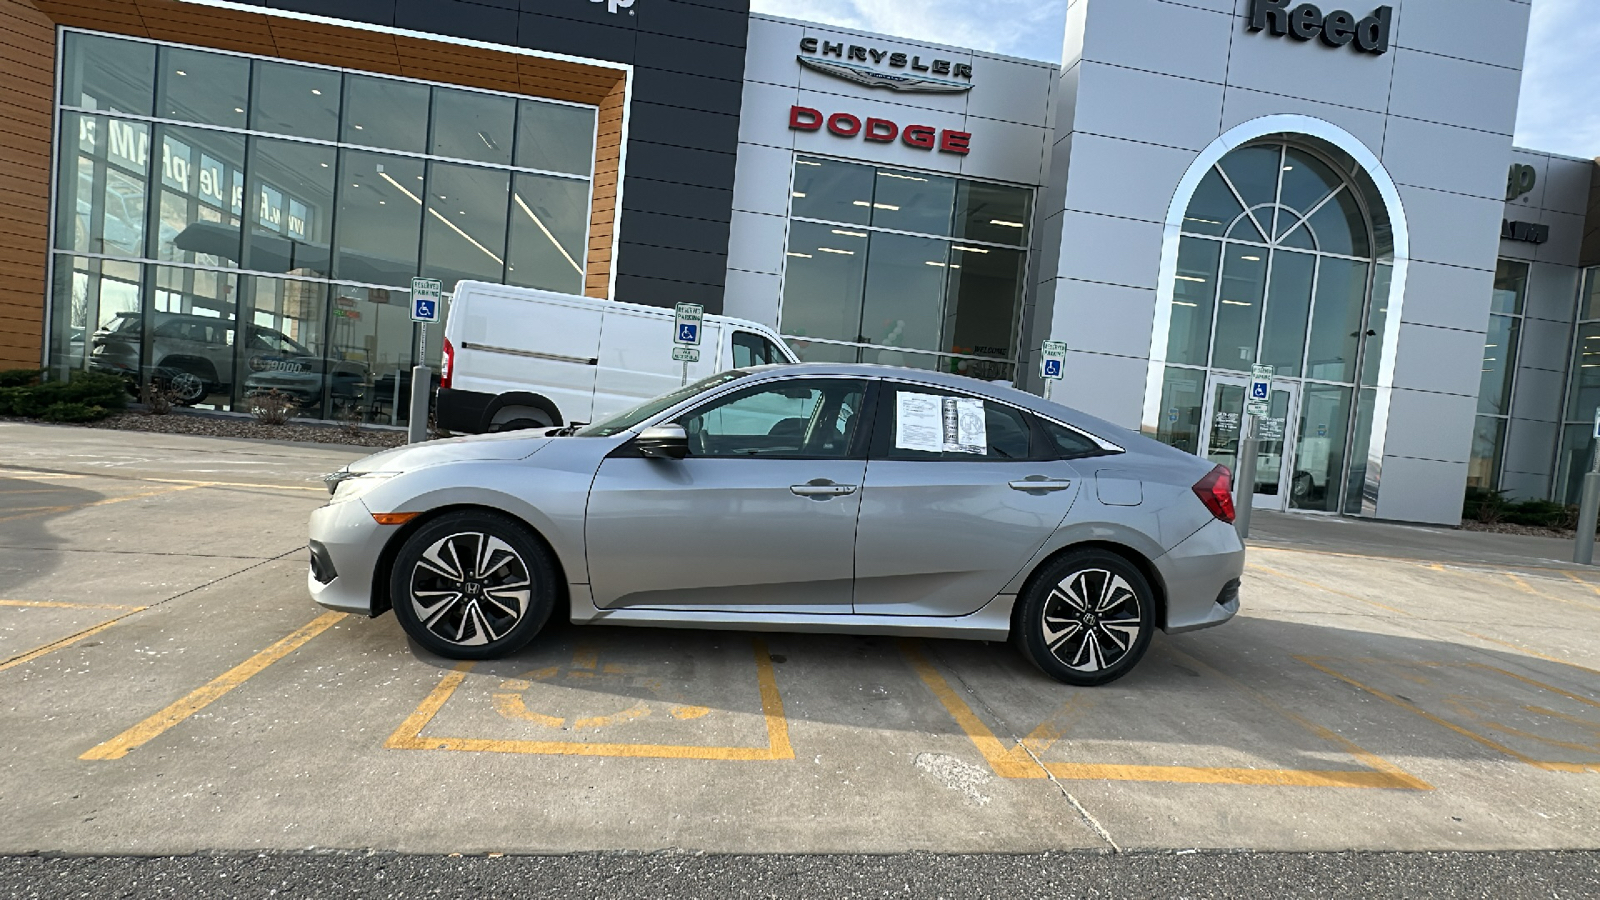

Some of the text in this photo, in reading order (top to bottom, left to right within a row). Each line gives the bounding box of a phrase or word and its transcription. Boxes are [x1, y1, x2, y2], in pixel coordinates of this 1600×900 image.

[1249, 0, 1392, 55] Reed
[799, 37, 973, 78] CHRYSLER
[788, 105, 972, 154] DODGE
[413, 289, 439, 298] PARKING
[414, 281, 439, 290] RESERVED
[974, 345, 1008, 356] WELCOME
